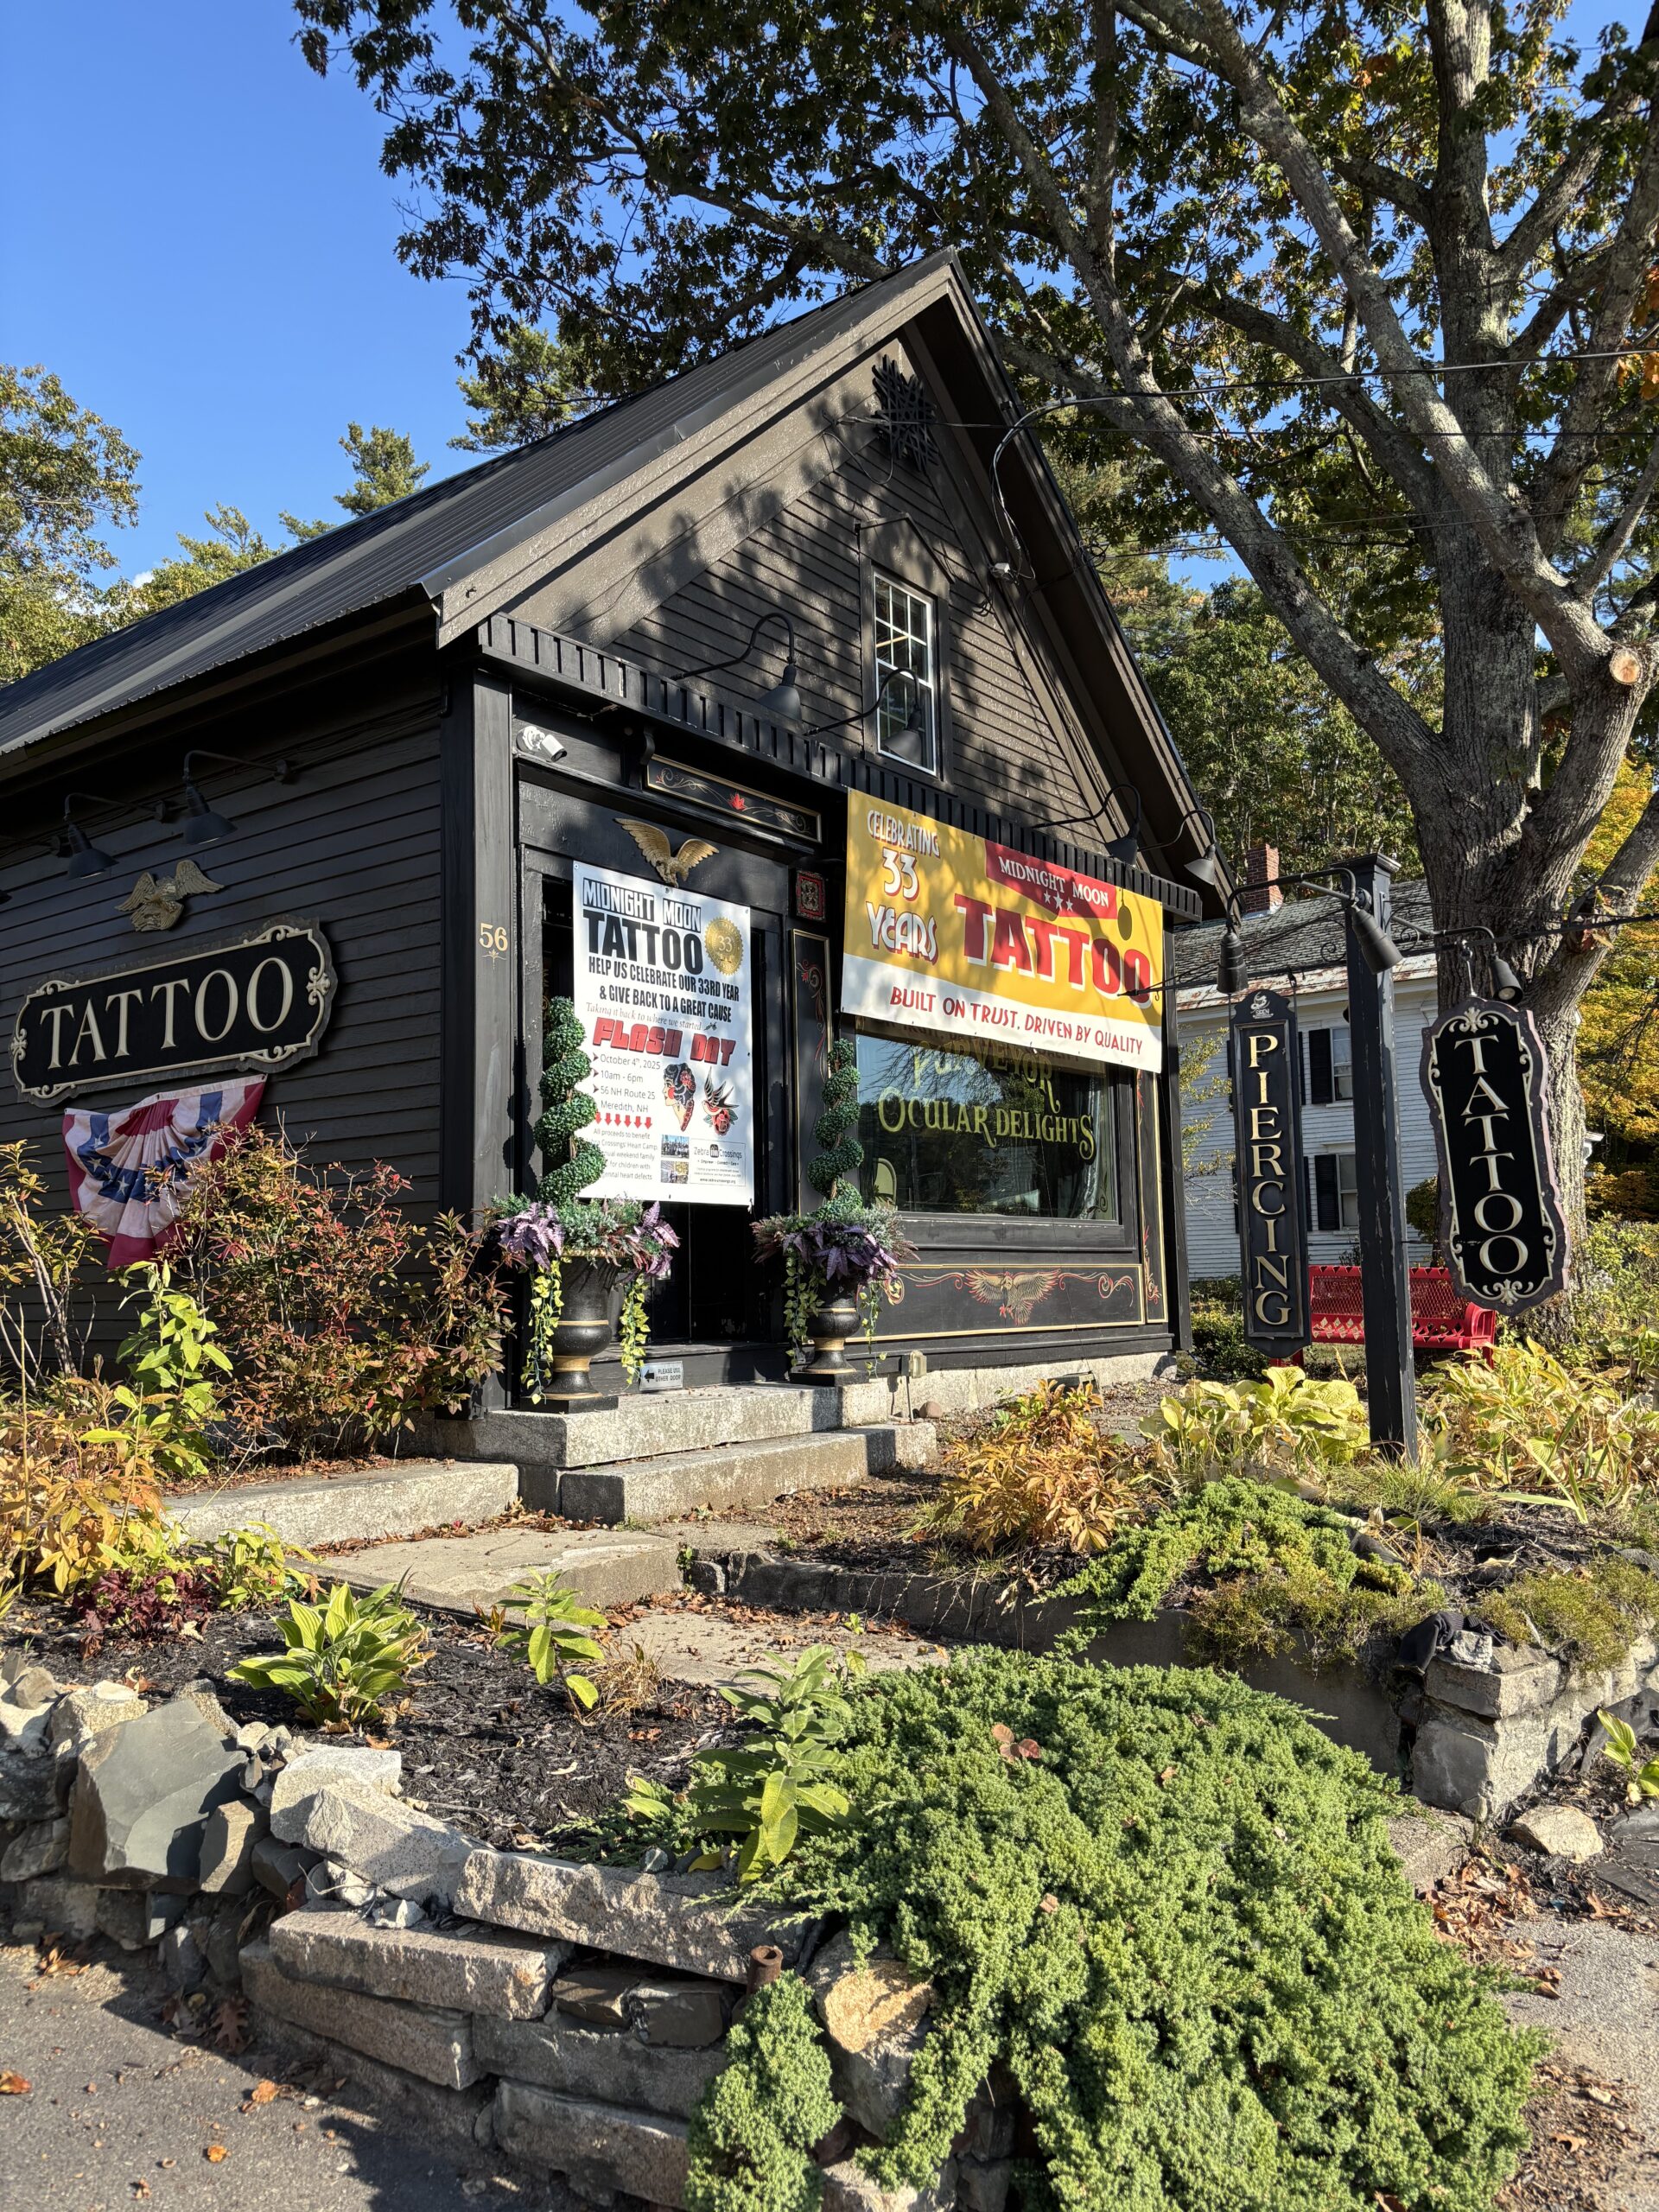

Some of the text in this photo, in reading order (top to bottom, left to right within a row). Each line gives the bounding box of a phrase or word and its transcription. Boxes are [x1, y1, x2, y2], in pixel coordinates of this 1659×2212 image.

[867, 810, 941, 858] CELEBRATING
[882, 847, 920, 901] 33
[998, 856, 1109, 907] MIDNIGHT MOON
[583, 878, 701, 933] MIDNIGHT MOON
[480, 923, 508, 951] 56
[583, 909, 703, 975] TATTOO
[718, 935, 733, 952] 33
[866, 900, 939, 965] YEARS
[954, 893, 1153, 1009] TATTOO
[588, 957, 740, 1001] HELP US CELEBRATE OUR 33RD YEAR
[600, 985, 732, 1022] & GIVE BACK TO A GREAT CAUSE
[40, 957, 294, 1070] TATTOO
[586, 1002, 611, 1017] Taking
[613, 1006, 619, 1016] it
[620, 1007, 636, 1020] back
[638, 1013, 645, 1021] to
[646, 1014, 667, 1025] where
[679, 1020, 702, 1031] started
[890, 986, 936, 1013] BUILT
[943, 997, 965, 1019] ON
[1025, 1014, 1072, 1039] DRIVEN
[1076, 1025, 1091, 1043] BY
[1095, 1030, 1143, 1055] QUALITY
[592, 1016, 736, 1066] FLASH DAY
[600, 1053, 631, 1065] October
[643, 1059, 661, 1070] 2025
[601, 1070, 620, 1081] 10am
[627, 1073, 644, 1084] 6pm
[601, 1085, 656, 1100] 56 NH Route 25
[601, 1100, 649, 1113] Meredith, NH
[878, 1086, 1096, 1160] OCULAR DELIGHTS
[639, 1153, 655, 1161] family
[694, 1147, 743, 1160] Zebra Crossings
[1453, 1034, 1529, 1275] TATTOO
[1248, 1033, 1292, 1326] PIERCING
